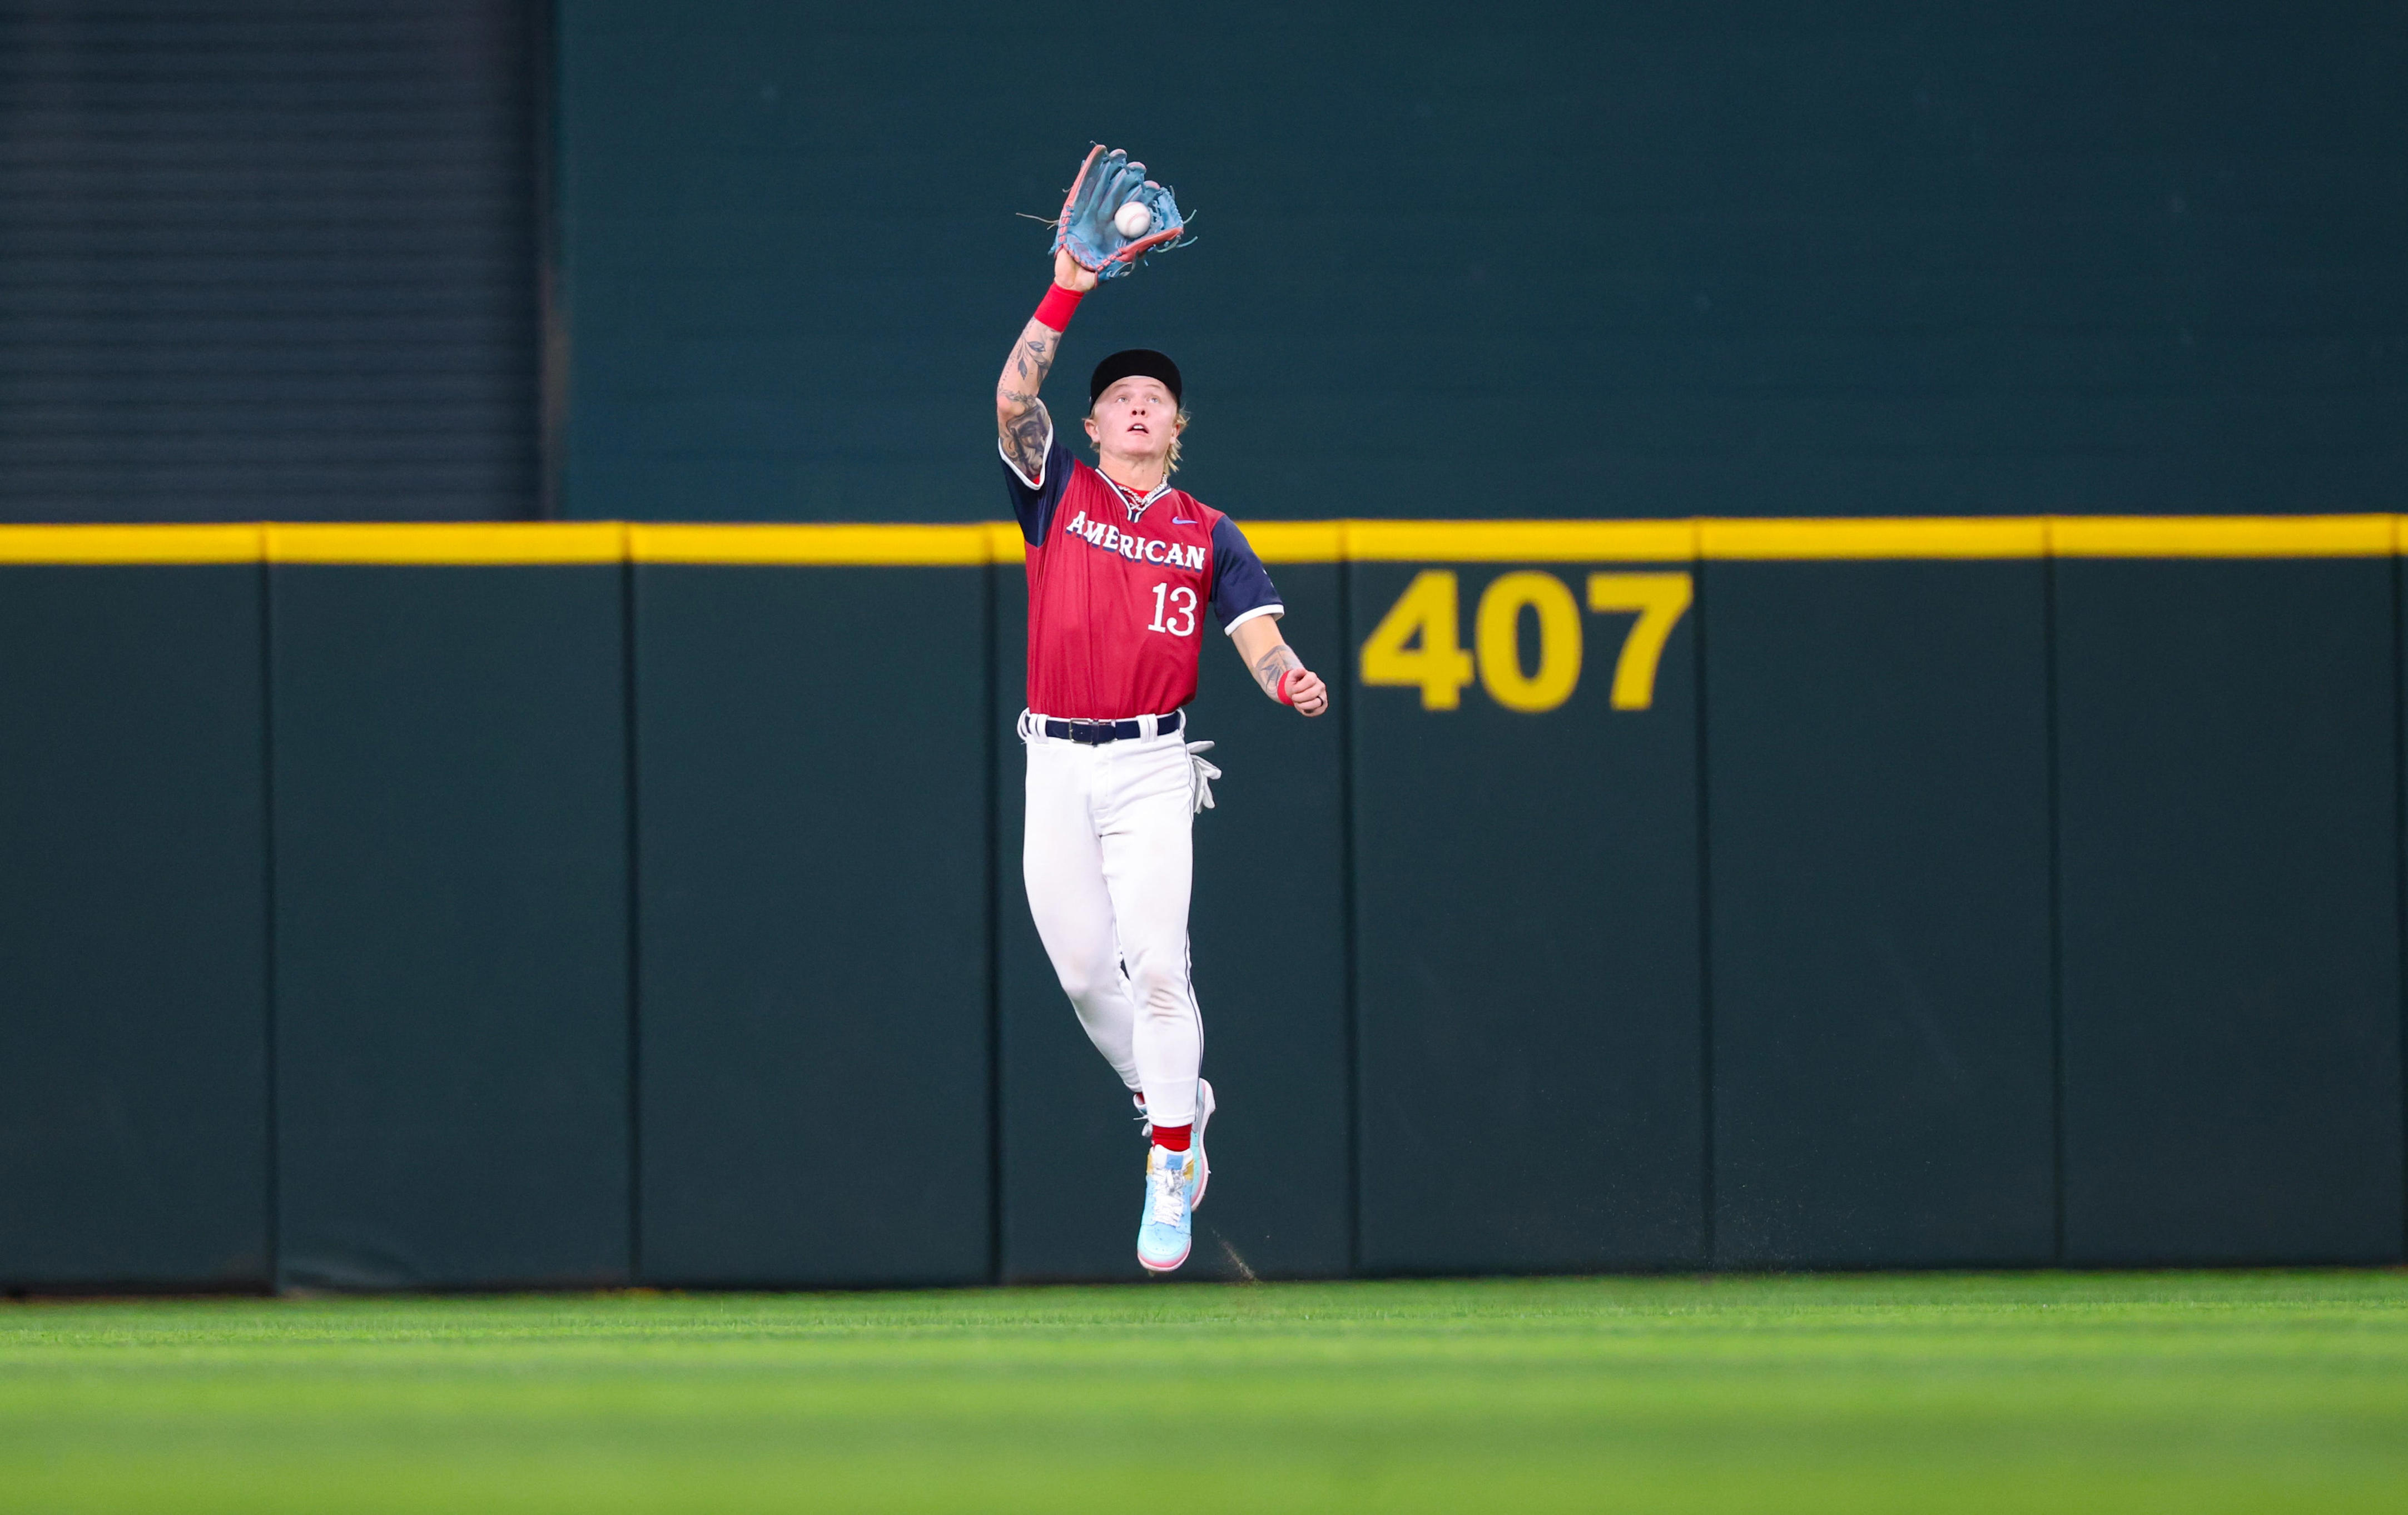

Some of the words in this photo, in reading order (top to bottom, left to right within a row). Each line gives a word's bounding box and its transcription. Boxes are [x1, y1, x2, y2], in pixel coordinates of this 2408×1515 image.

[1066, 510, 1206, 572] AMERICAN
[1148, 582, 1198, 637] 13
[1359, 569, 1694, 713] 407
